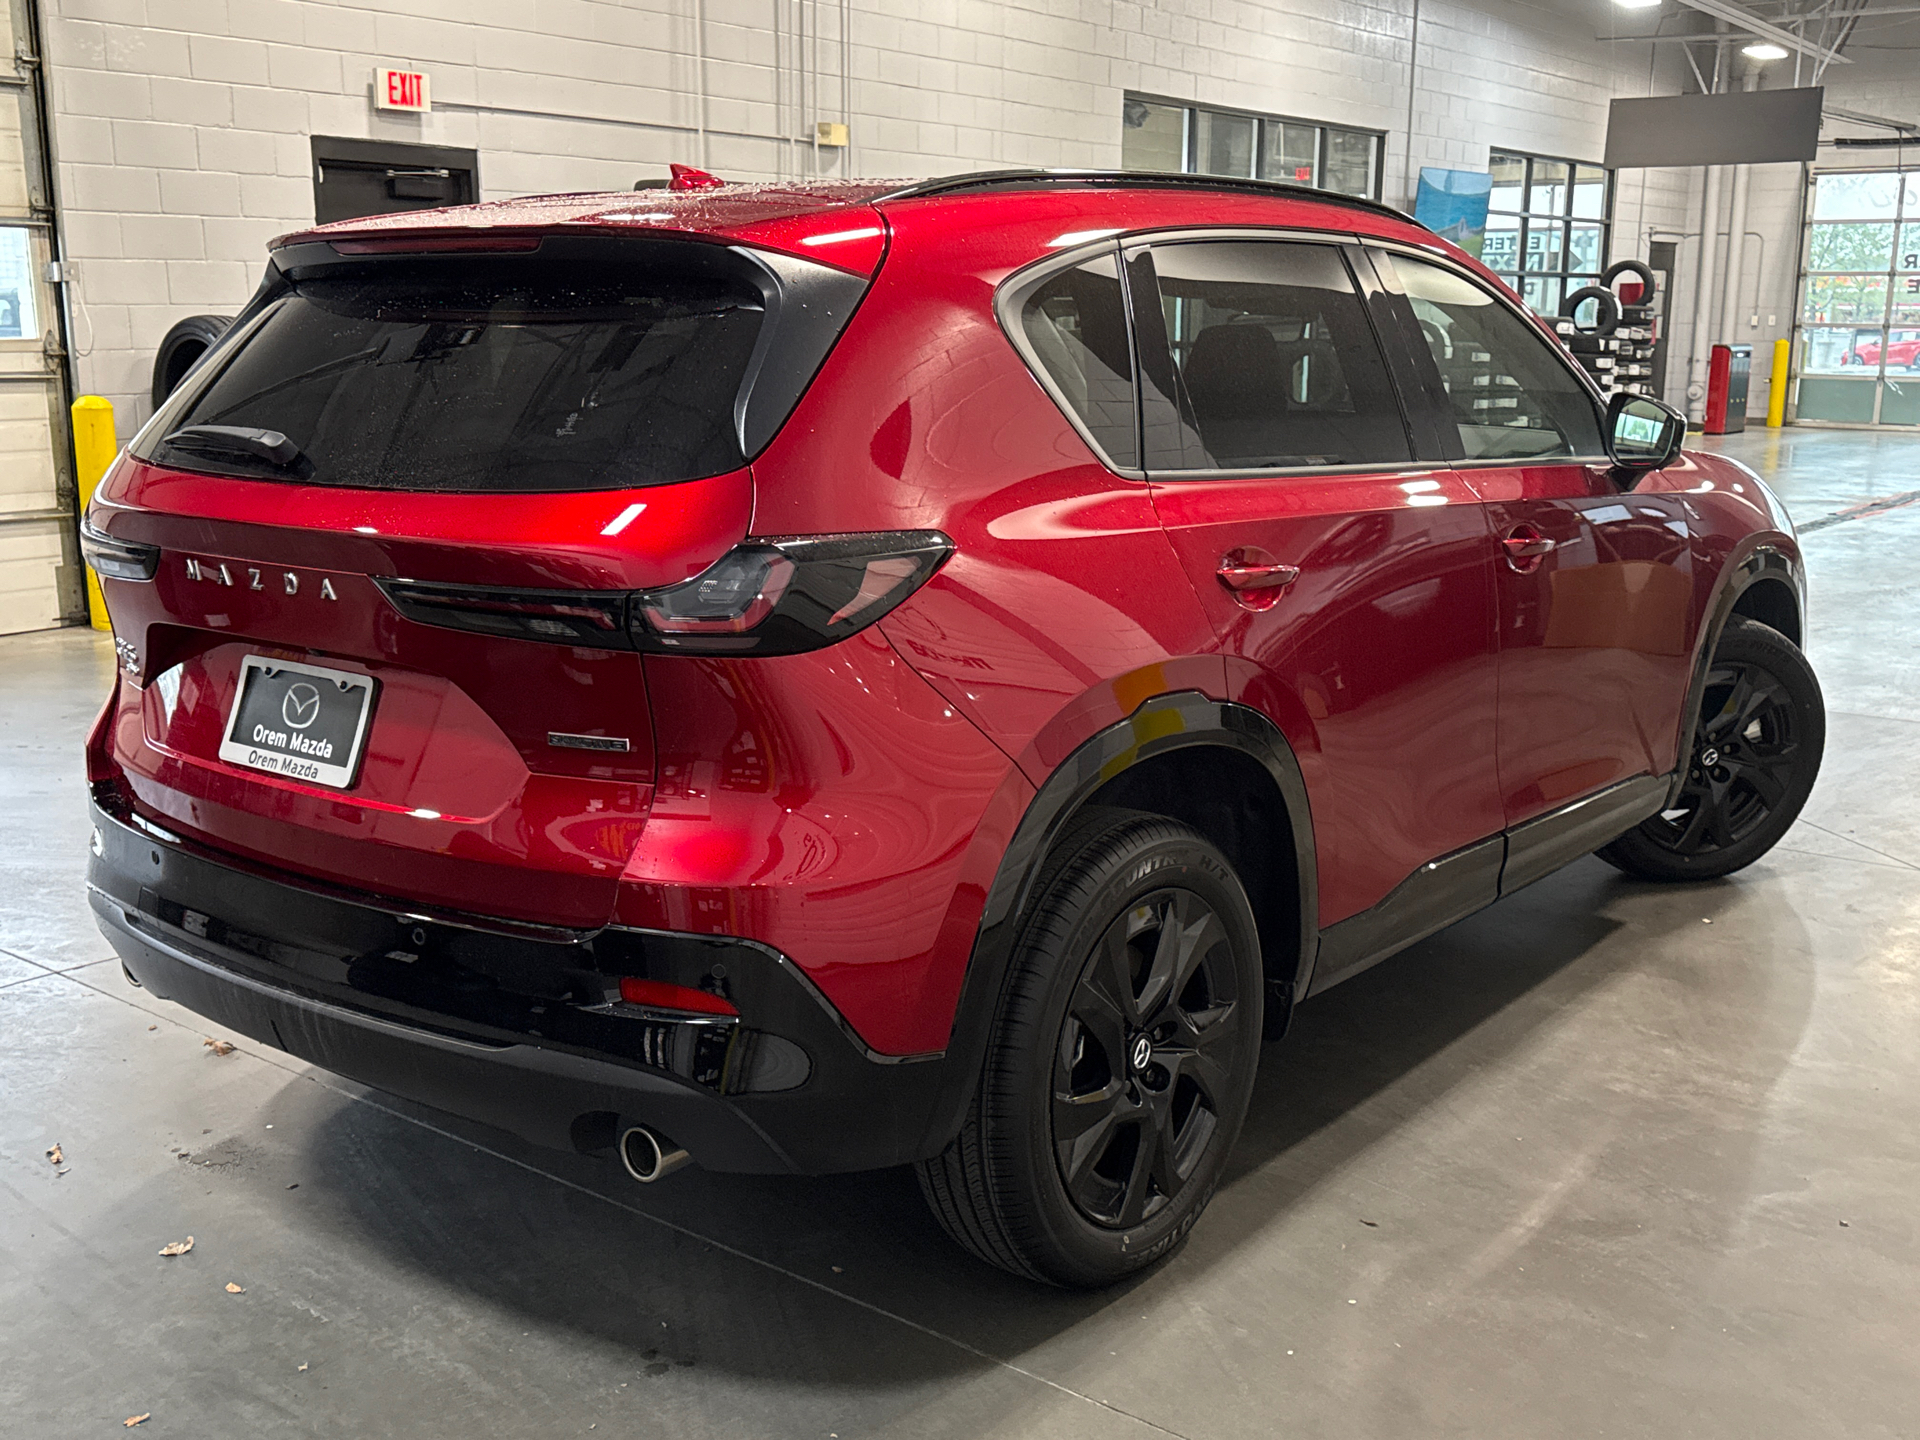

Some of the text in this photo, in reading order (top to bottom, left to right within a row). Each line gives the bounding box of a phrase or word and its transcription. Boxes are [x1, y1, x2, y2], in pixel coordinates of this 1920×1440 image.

[387, 71, 423, 107] EXIT
[186, 558, 337, 600] MAZDA
[253, 723, 333, 758] Orem Mazda
[248, 749, 319, 779] Orem Mazda
